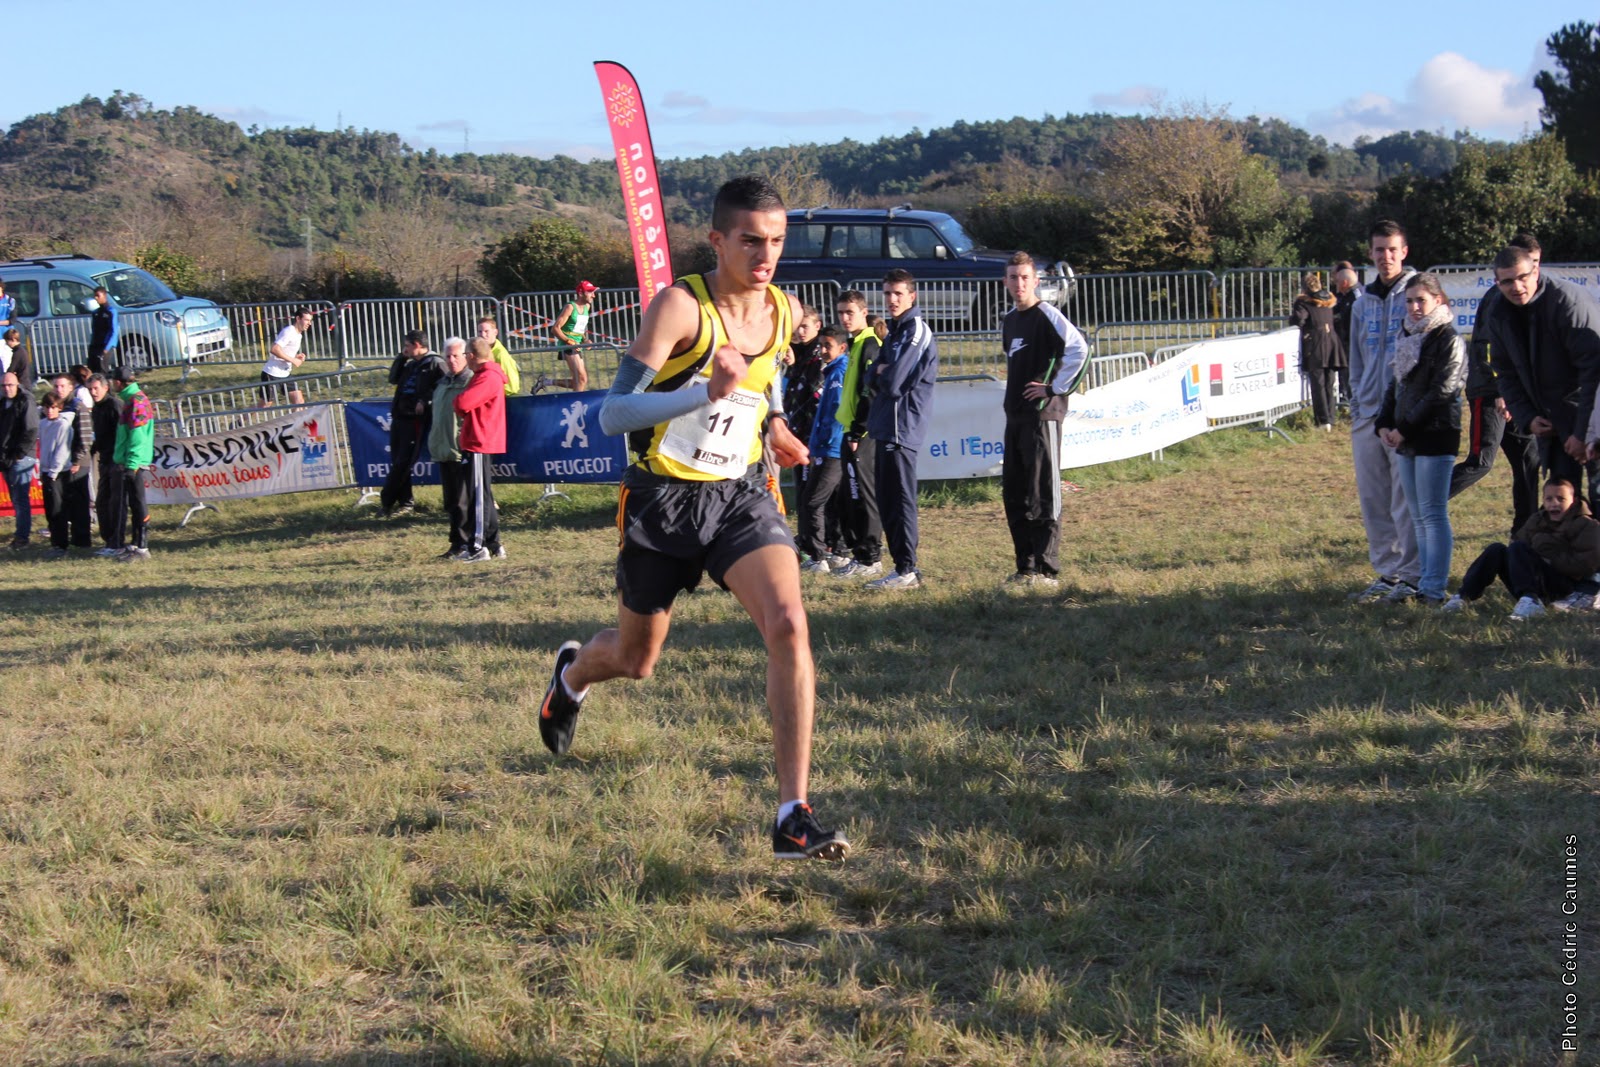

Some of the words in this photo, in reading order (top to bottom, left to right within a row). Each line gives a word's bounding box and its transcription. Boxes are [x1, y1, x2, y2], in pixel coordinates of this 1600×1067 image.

[708, 412, 735, 437] 11
[698, 450, 724, 466] Libre
[930, 440, 949, 457] et
[960, 436, 1005, 458] l'Epa
[543, 457, 613, 476] PEUGEOT
[150, 465, 189, 497] Sport
[193, 472, 231, 496] pour
[233, 465, 271, 482] tous
